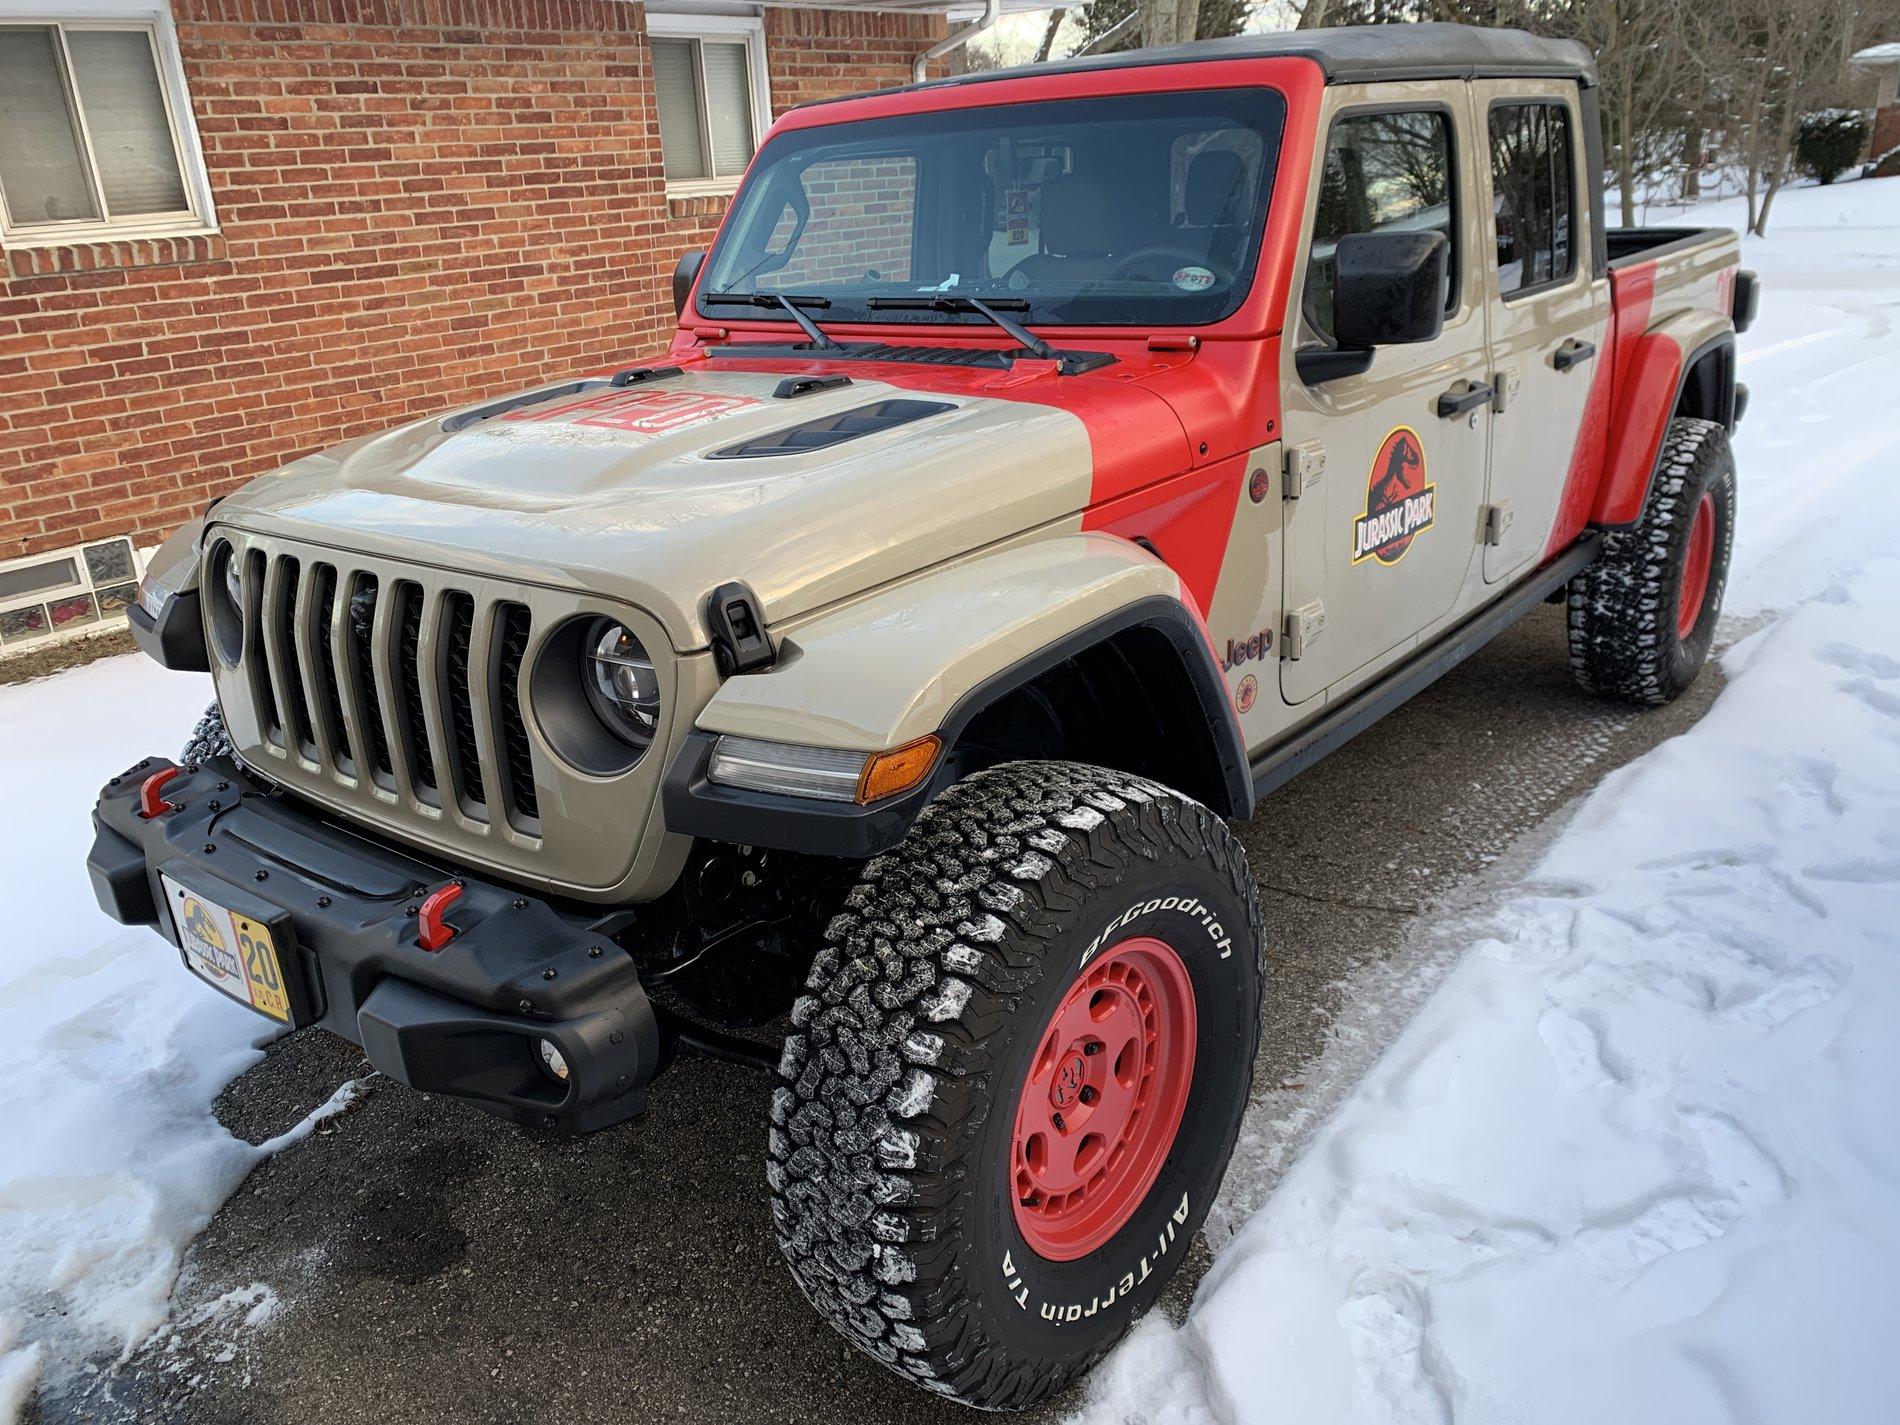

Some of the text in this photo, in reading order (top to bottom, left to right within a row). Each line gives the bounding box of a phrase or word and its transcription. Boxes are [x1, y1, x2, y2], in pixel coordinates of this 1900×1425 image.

[1354, 492, 1434, 559] JURASSIC PARK
[1221, 628, 1274, 673] Jeep
[239, 933, 279, 991] 20
[1002, 1249, 1029, 1310] T/A
[1040, 1191, 1189, 1327] All-Terrain
